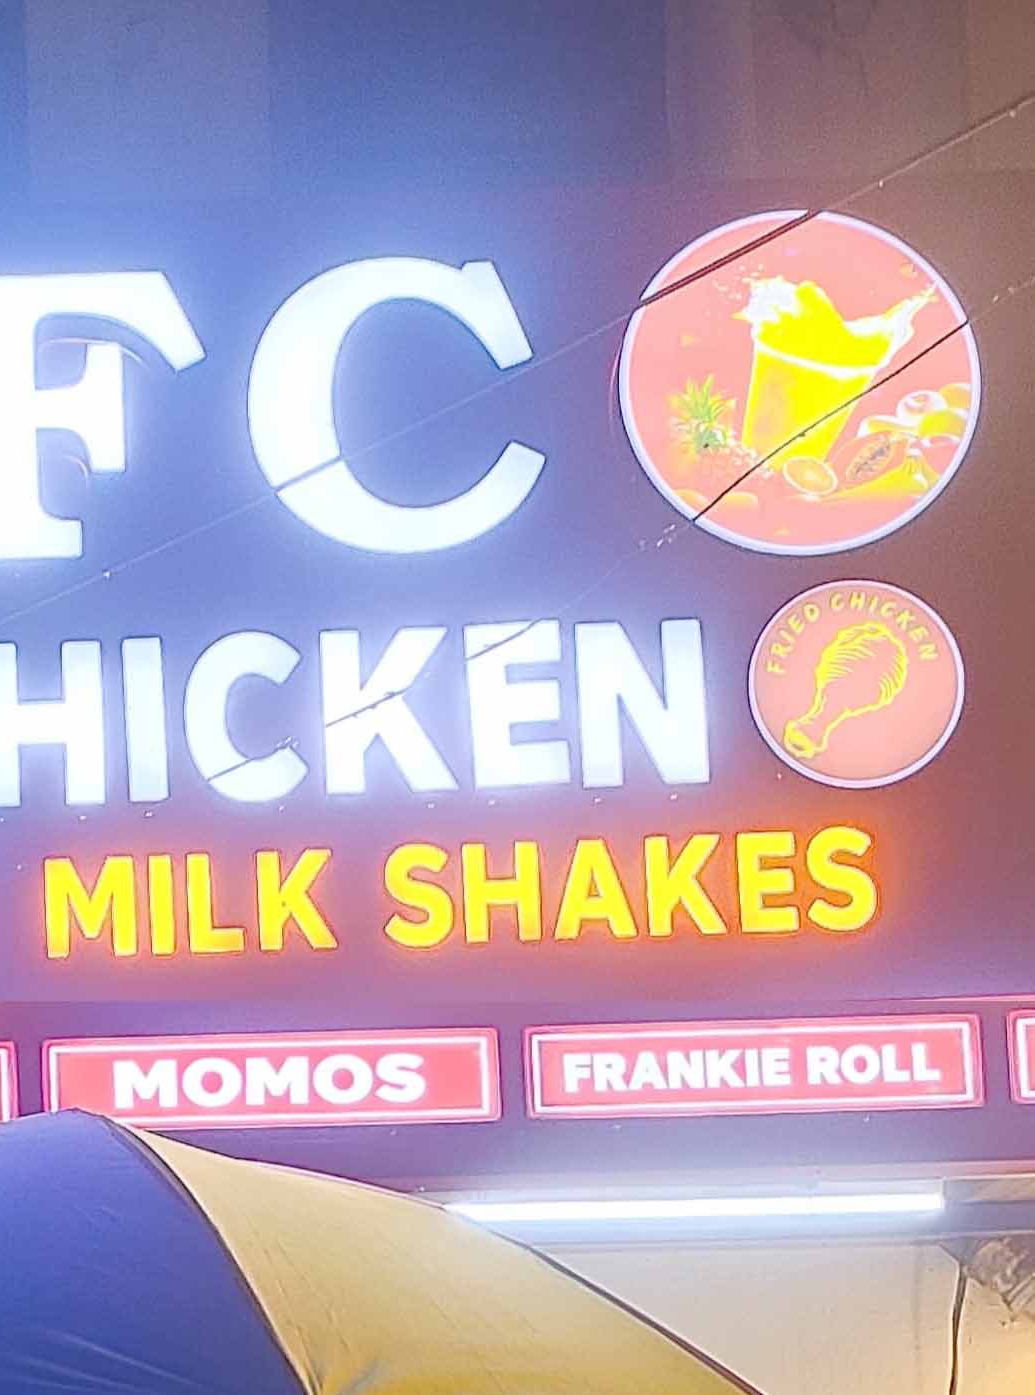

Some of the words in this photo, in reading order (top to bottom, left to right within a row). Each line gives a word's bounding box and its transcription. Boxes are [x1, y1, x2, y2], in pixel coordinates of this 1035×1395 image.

[766, 603, 820, 675] FRIED
[830, 592, 939, 661] CHICKEN
[44, 849, 338, 959] MILK
[384, 826, 878, 948] SHAKES
[113, 1053, 427, 1109] MOMOS
[564, 1048, 792, 1090] FRANKIE
[808, 1039, 940, 1085] ROLL
